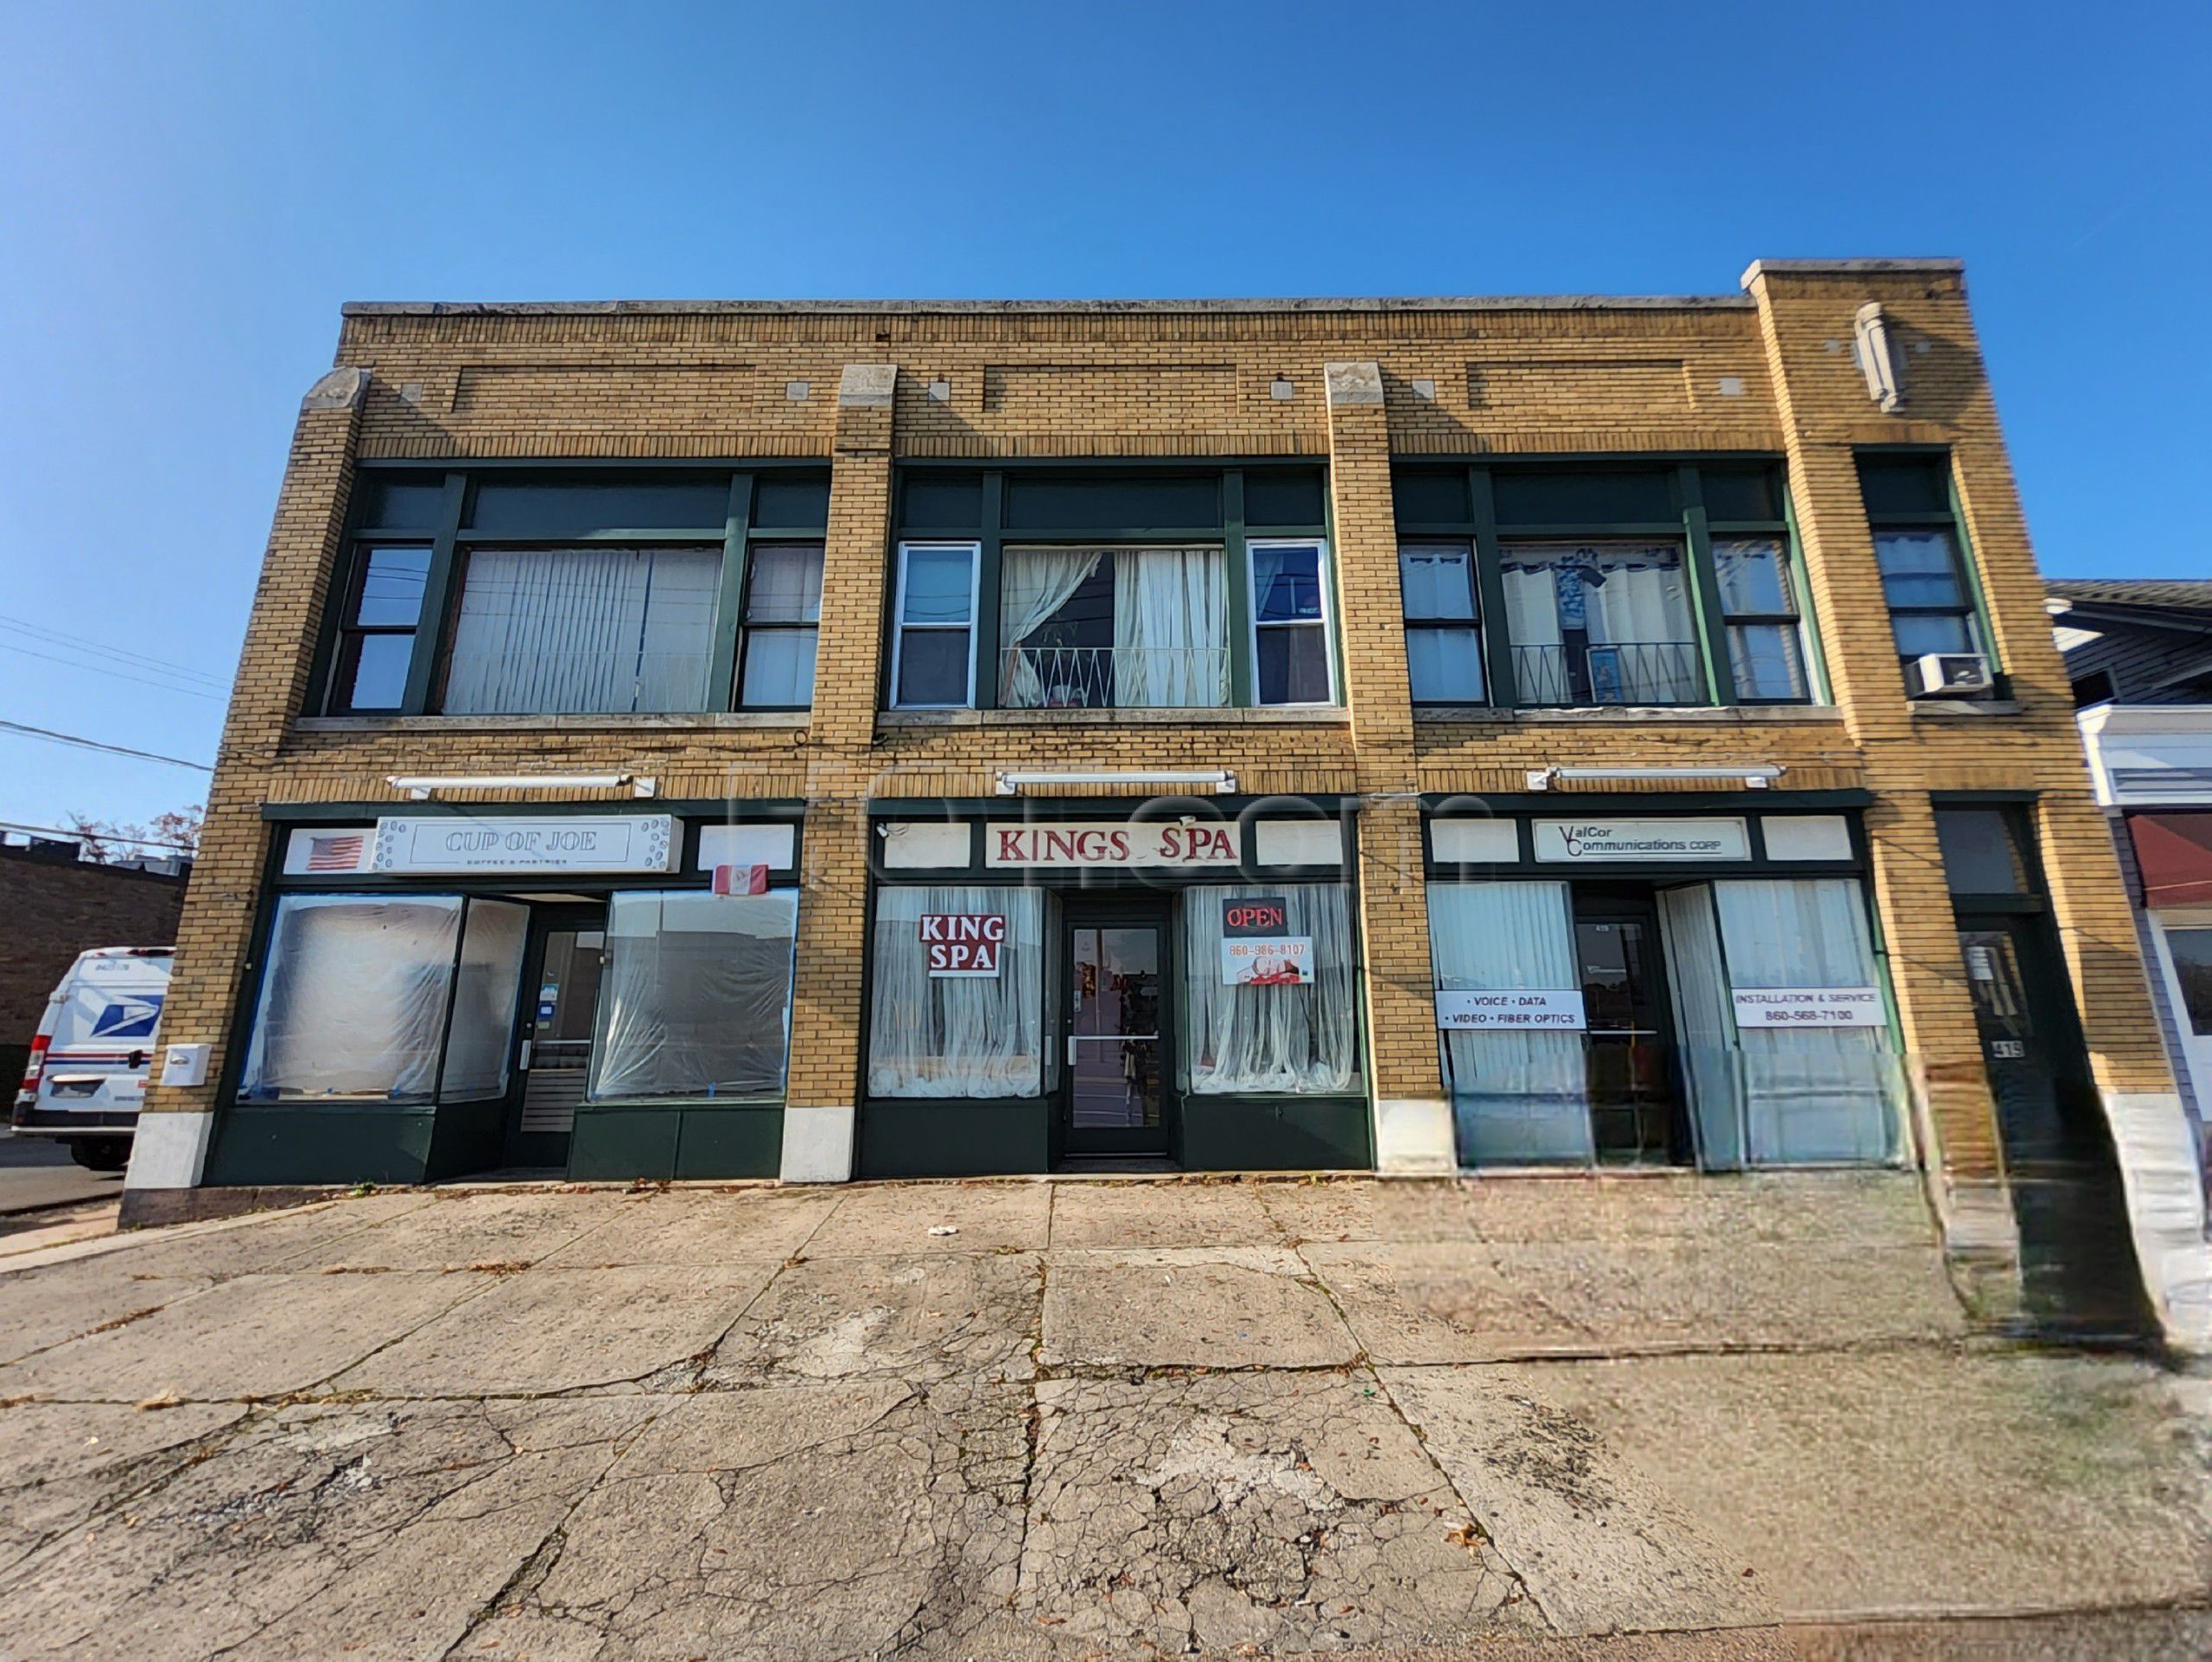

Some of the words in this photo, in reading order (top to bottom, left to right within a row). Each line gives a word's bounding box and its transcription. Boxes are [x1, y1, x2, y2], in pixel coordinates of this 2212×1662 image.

[445, 831, 499, 851] CUP
[505, 831, 542, 851] OF
[545, 830, 598, 851] JOE
[997, 827, 1130, 863] KINGS
[1160, 826, 1237, 861] SPA
[1567, 838, 1687, 857] Communications
[1226, 907, 1283, 927] OPEN
[921, 915, 1005, 941] KING
[930, 944, 994, 969] SPA
[1229, 944, 1306, 956] 860-986-8107
[1474, 997, 1508, 1006] VOICE
[1518, 997, 1547, 1006] DATA
[1735, 994, 1814, 1004] INSTALLATION
[1817, 994, 1825, 1003] &
[1828, 993, 1877, 1003] SERVICE
[1452, 1014, 1487, 1023] VIDEO
[1497, 1014, 1531, 1023] FIBER
[1534, 1014, 1576, 1023] OPTICS
[1765, 1009, 1853, 1021] 860-568-7100
